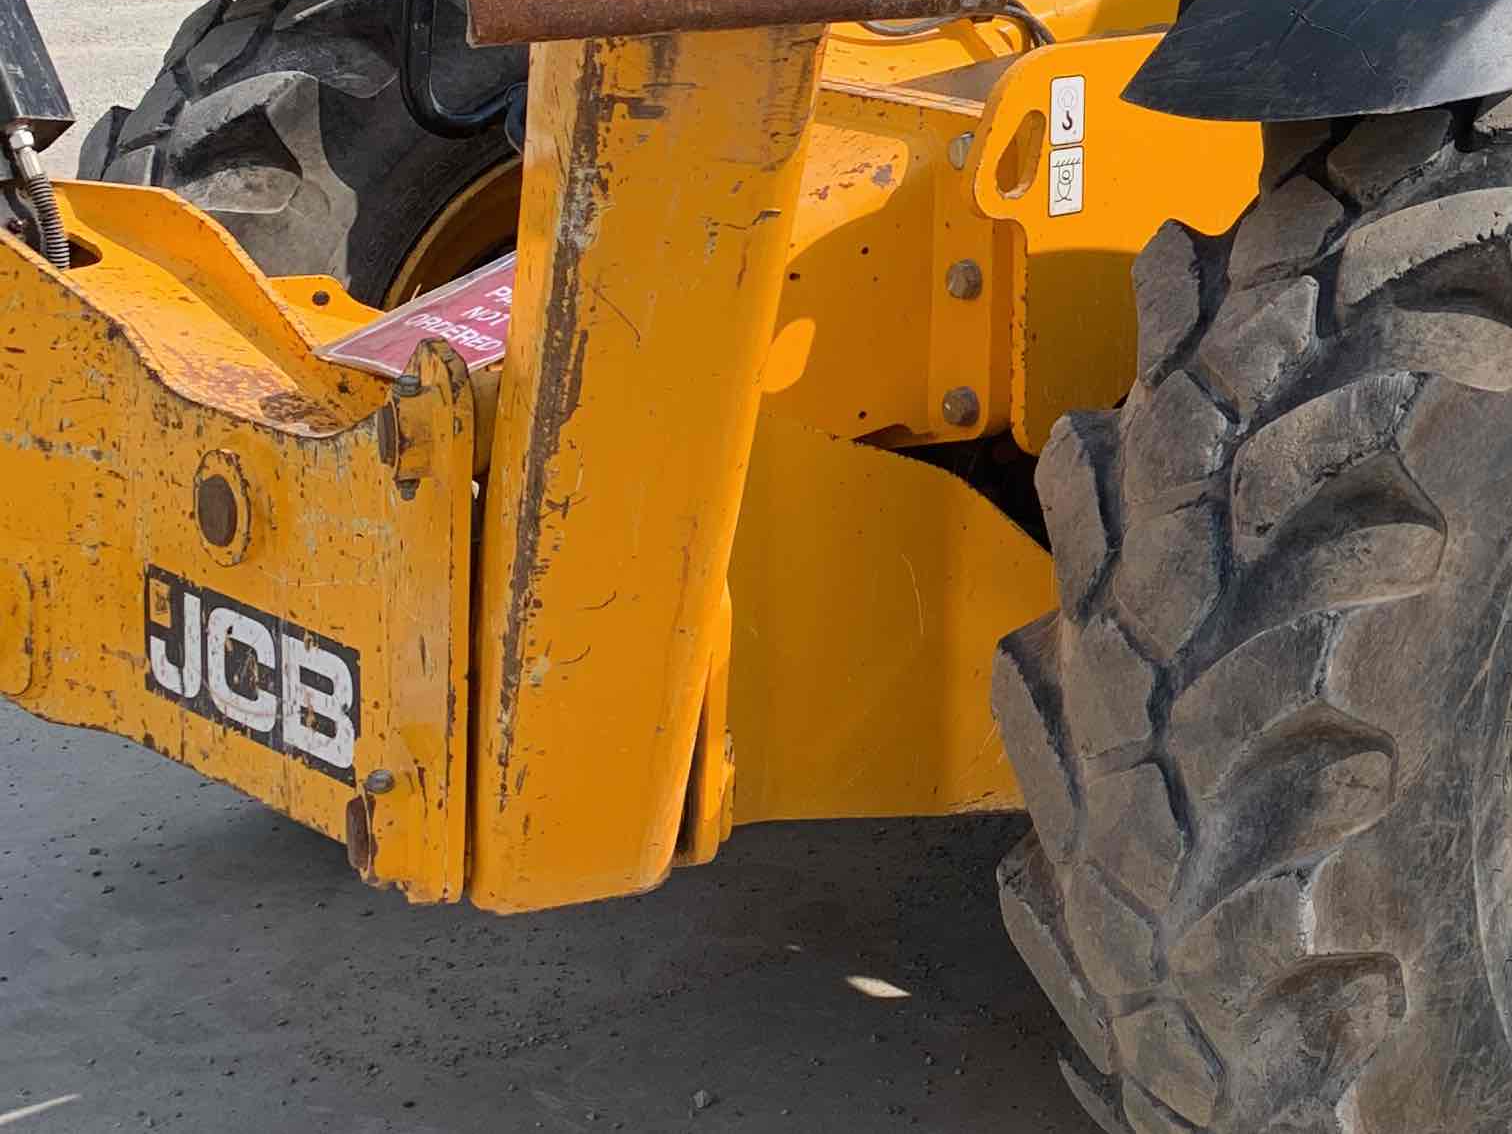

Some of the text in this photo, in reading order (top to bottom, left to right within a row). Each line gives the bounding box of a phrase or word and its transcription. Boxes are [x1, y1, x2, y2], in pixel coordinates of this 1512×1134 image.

[404, 313, 503, 351] ORDERED
[459, 306, 510, 327] NOT
[150, 592, 356, 768] JCB
